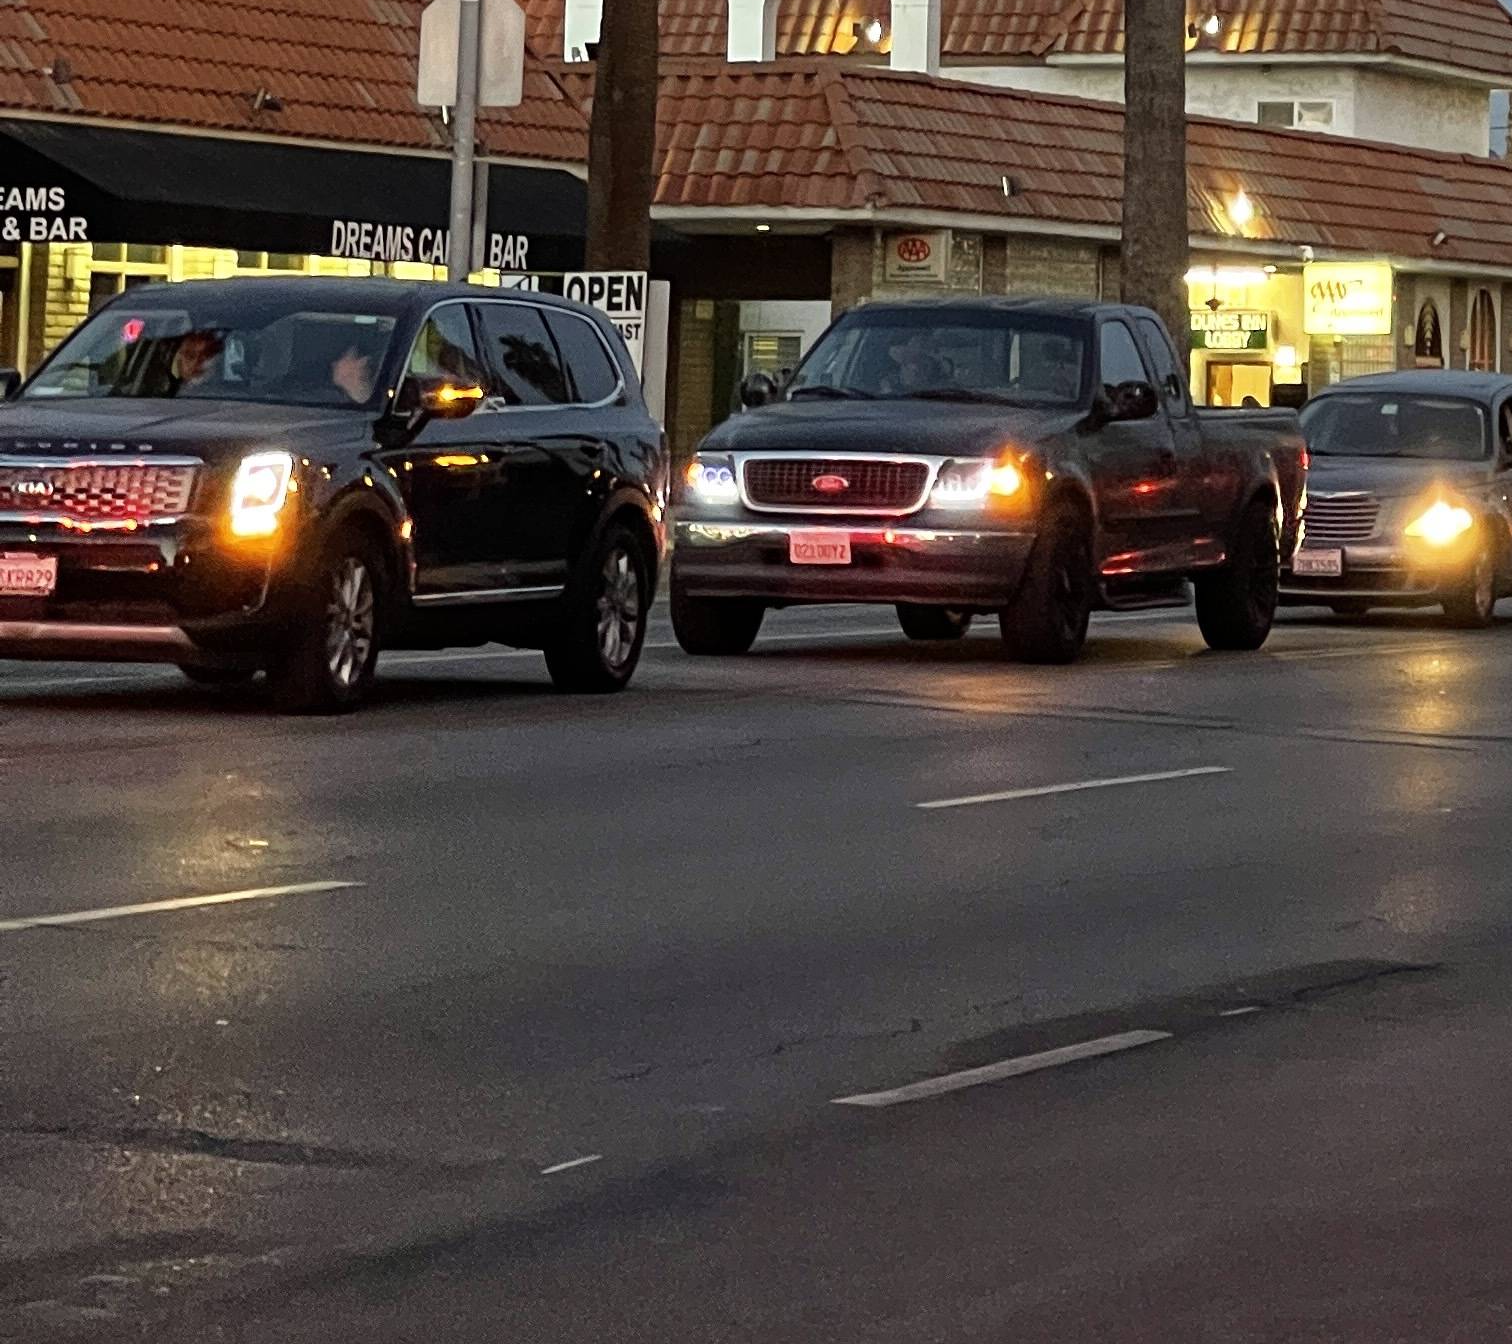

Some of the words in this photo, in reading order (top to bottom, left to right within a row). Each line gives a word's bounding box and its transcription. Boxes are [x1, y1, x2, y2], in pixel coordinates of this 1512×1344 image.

[2, 216, 21, 241] &
[29, 216, 88, 241] BAR
[331, 219, 413, 262] DREAMS
[418, 227, 450, 263] CA
[489, 233, 529, 270] BAR
[566, 275, 644, 312] OPEN
